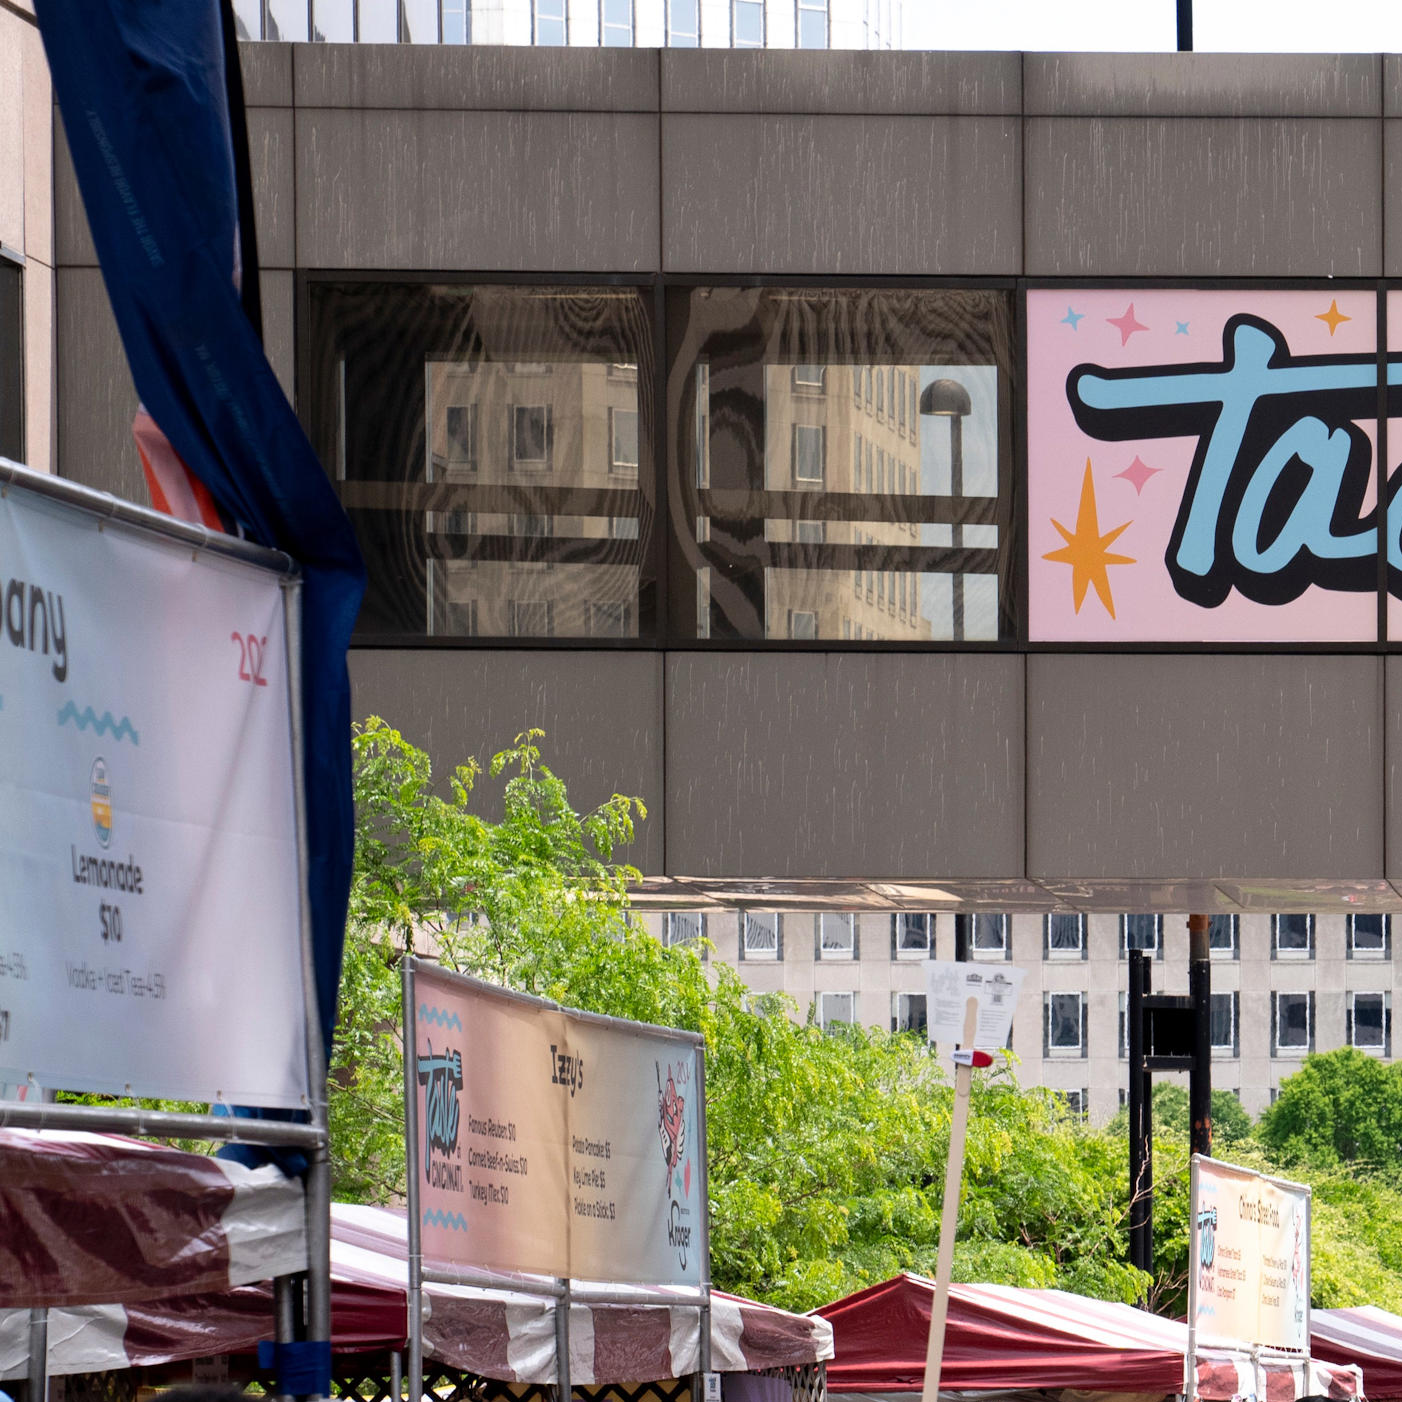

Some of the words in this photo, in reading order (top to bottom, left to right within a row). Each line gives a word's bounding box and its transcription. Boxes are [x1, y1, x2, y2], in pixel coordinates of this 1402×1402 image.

[71, 843, 144, 895] Lemonade
[551, 1045, 584, 1098] Izzy's
[668, 1200, 691, 1271] Kroger
